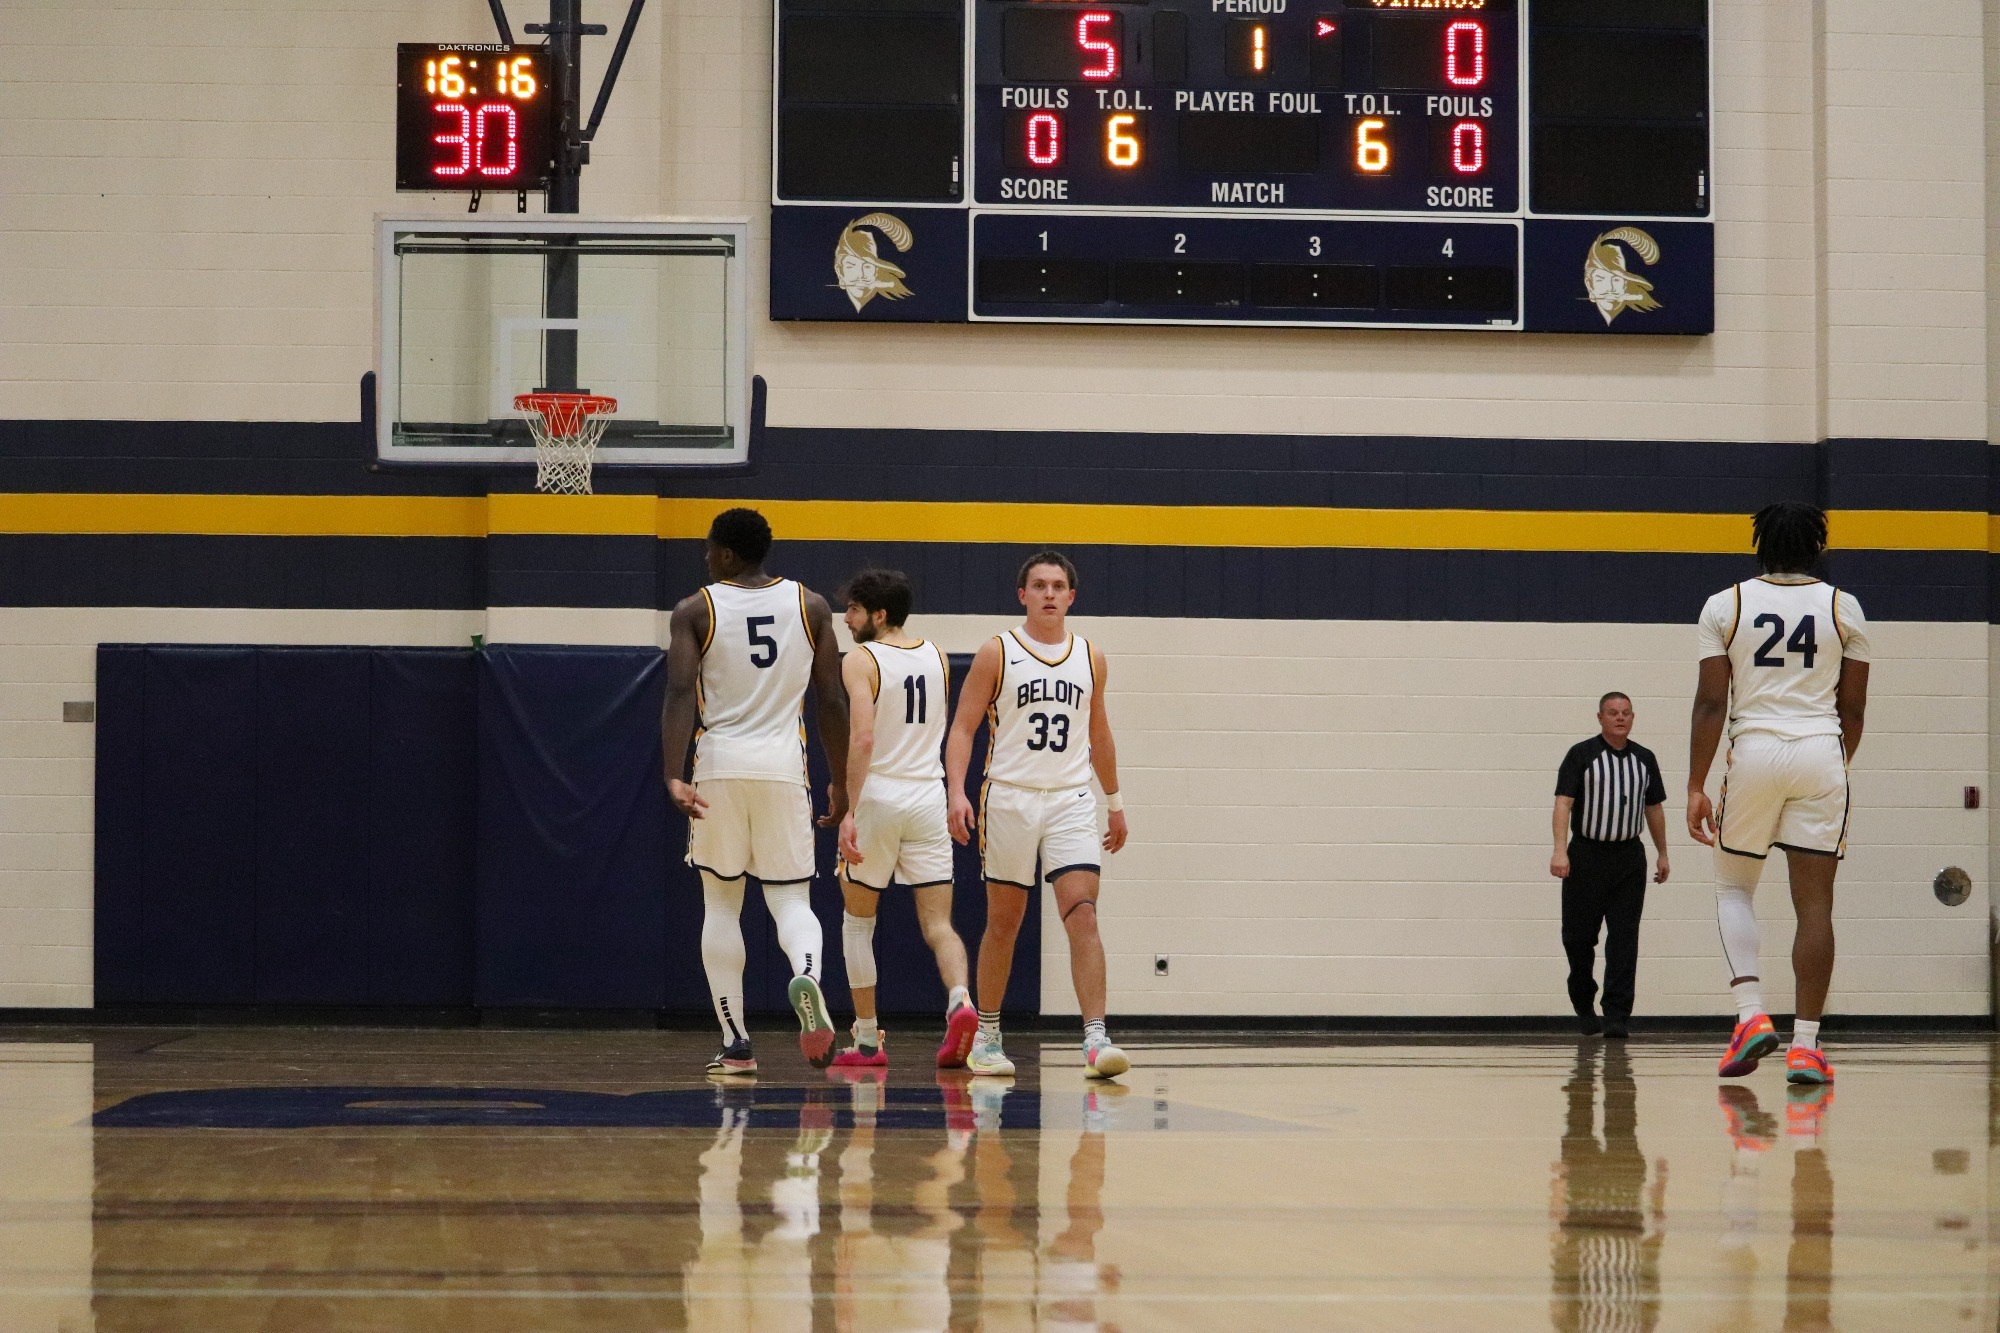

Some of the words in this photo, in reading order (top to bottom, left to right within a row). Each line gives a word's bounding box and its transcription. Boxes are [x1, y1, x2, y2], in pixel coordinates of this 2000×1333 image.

[1212, 0, 1286, 14] PERIOD
[438, 44, 511, 52] DAKTRONICS
[1078, 14, 1115, 78] 5
[1253, 27, 1264, 70] 1
[1447, 22, 1483, 85] 0
[1002, 87, 1069, 109] FOULS
[1095, 89, 1153, 111] T.O.L.
[1175, 90, 1255, 112] PLAYER
[1269, 92, 1322, 114] FOUL
[1344, 94, 1401, 115] T.O.L.
[1427, 95, 1493, 118] FOULS
[434, 104, 516, 175] 30
[1028, 114, 1057, 164] 0
[1108, 115, 1139, 166] 6
[1357, 120, 1388, 171] 6
[1453, 123, 1482, 172] 0
[1000, 177, 1068, 200] SCORE
[1211, 182, 1284, 204] MATCH
[1426, 186, 1494, 208] SCORE
[1038, 230, 1048, 251] 1
[1174, 233, 1187, 254] 2
[1309, 235, 1321, 257] 3
[1441, 238, 1454, 258] 4
[746, 615, 778, 669] 5
[1753, 613, 1818, 669] 24
[903, 674, 927, 724] 11
[1017, 678, 1084, 711] BELOIT
[1026, 712, 1070, 753] 33
